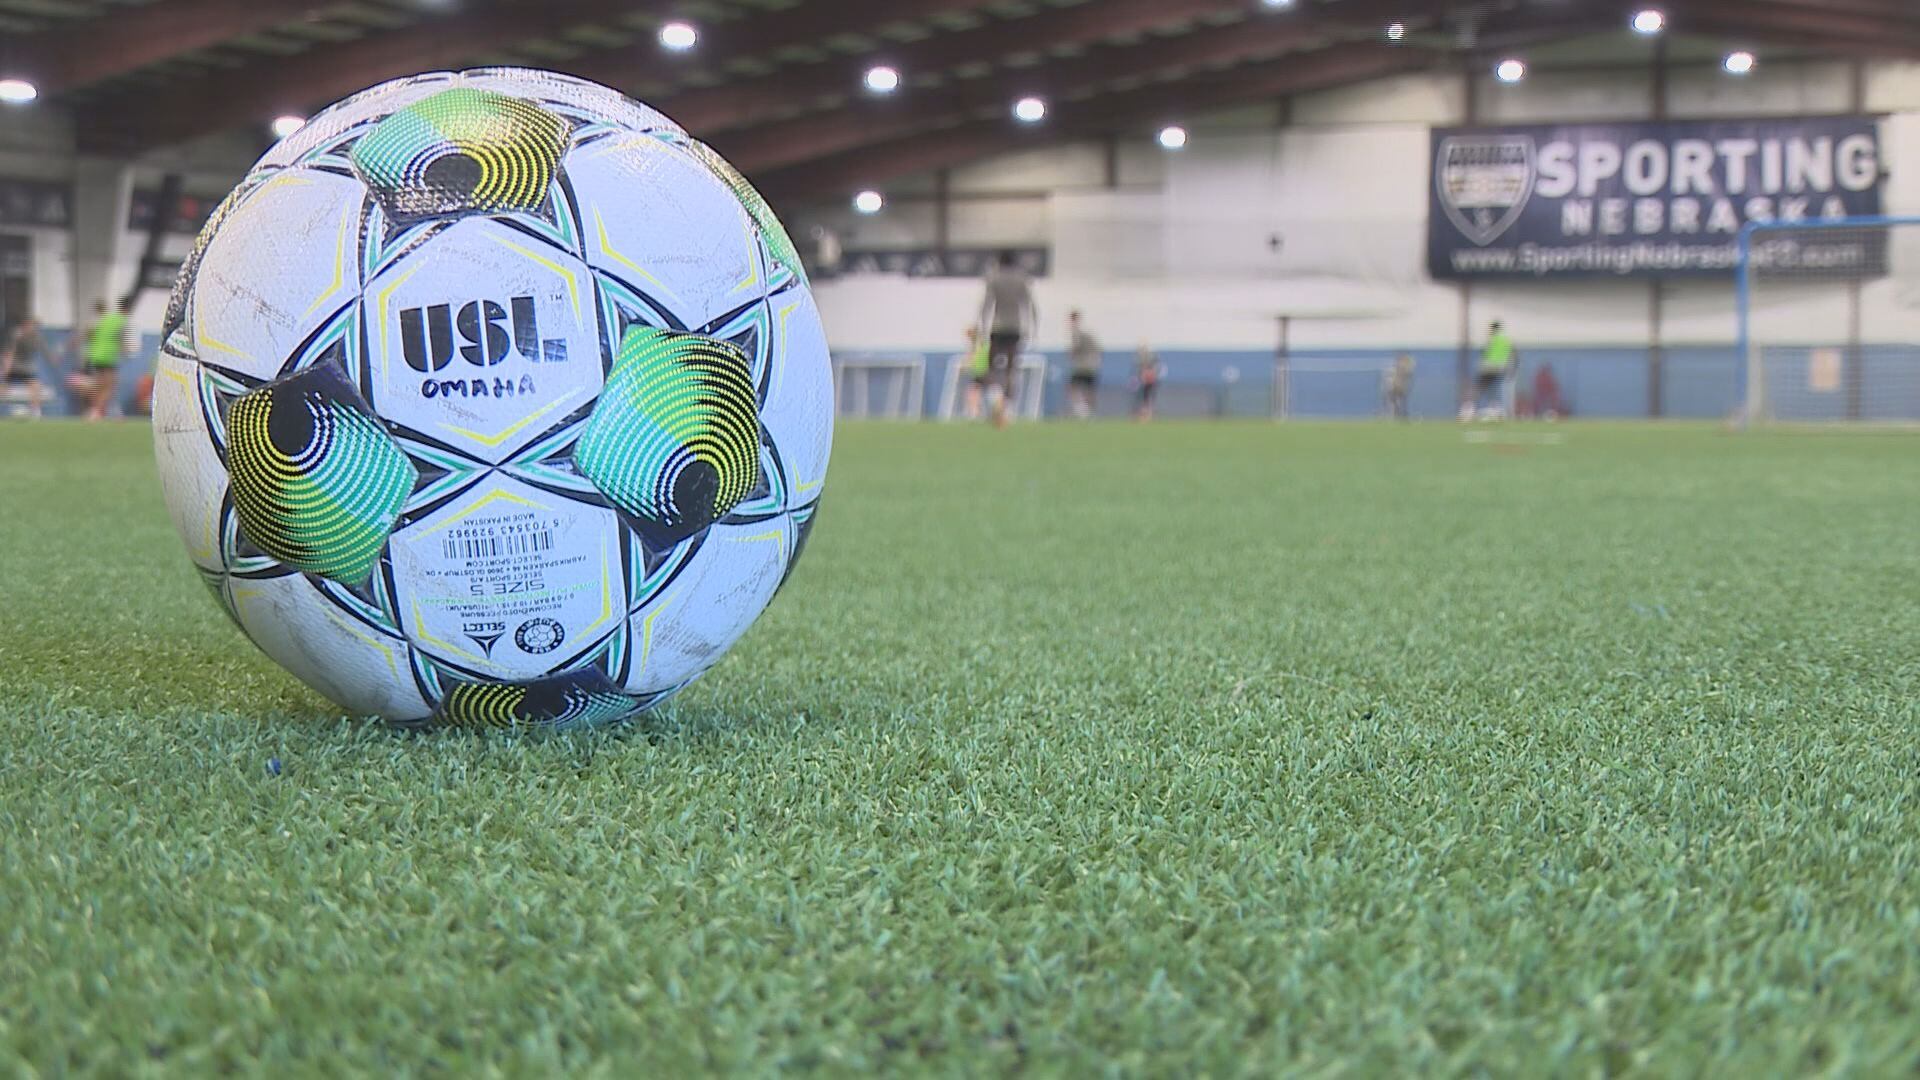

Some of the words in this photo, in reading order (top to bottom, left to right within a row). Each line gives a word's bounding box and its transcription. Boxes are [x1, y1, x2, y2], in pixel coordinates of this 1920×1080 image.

[1534, 134, 1877, 198] SPORTING
[1560, 195, 1848, 236] NEBRASKA
[399, 296, 568, 373] USL
[421, 373, 536, 398] OMAHA
[463, 517, 501, 526] PAKISTAN
[513, 512, 535, 521] MADE
[448, 527, 495, 539] 929962
[500, 520, 547, 535] 703543
[470, 584, 484, 596] 5
[493, 578, 545, 595] SIZE
[463, 621, 506, 632] SELECT
